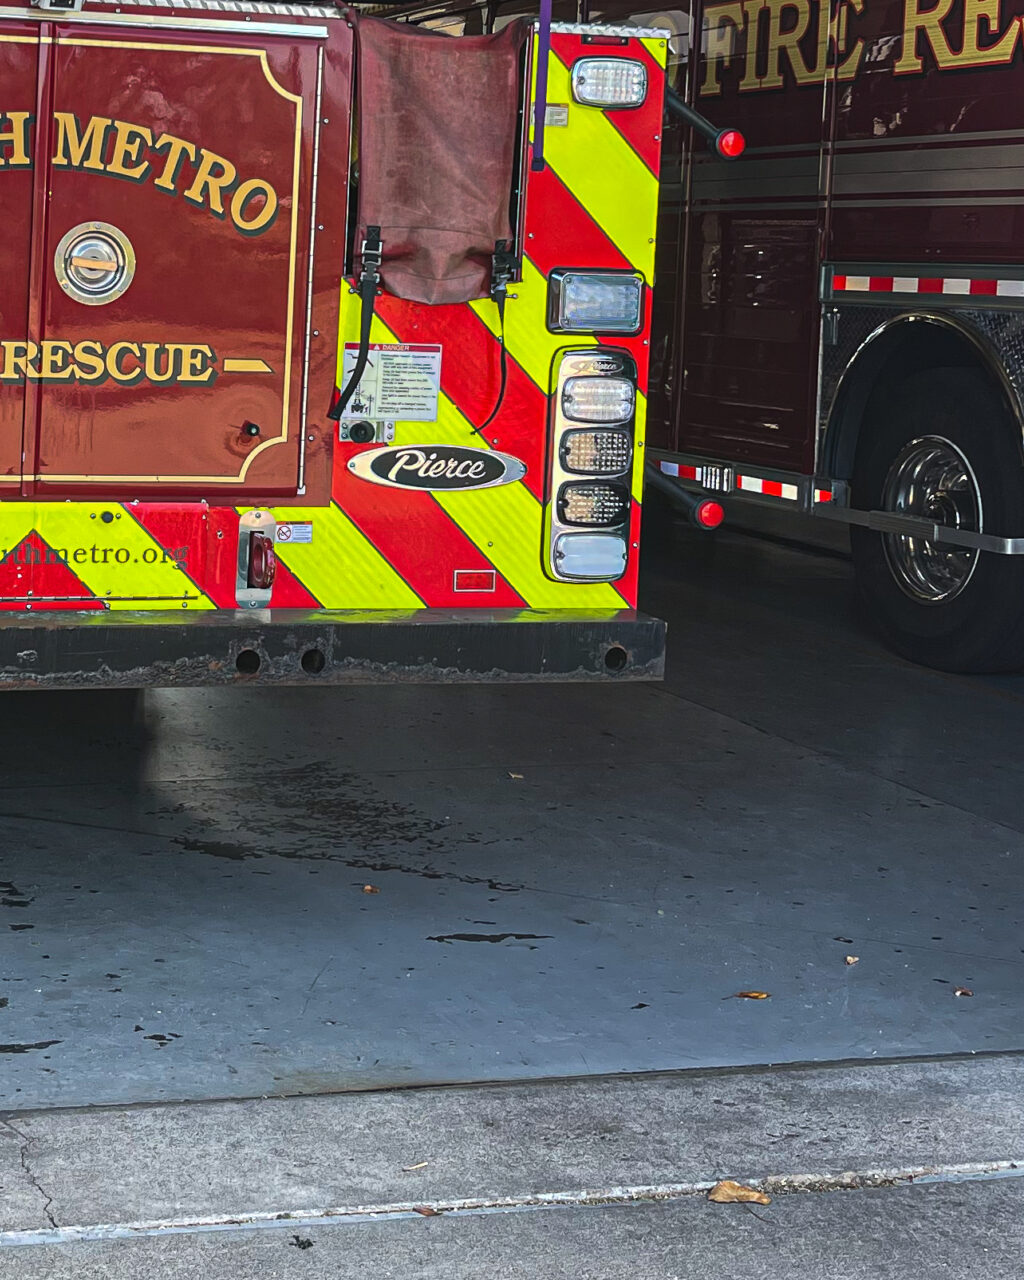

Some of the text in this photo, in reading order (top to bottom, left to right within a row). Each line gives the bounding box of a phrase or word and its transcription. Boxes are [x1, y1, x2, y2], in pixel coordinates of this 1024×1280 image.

[51, 111, 279, 233] METRO
[382, 344, 410, 352] DANGER
[387, 449, 486, 482] Pierce
